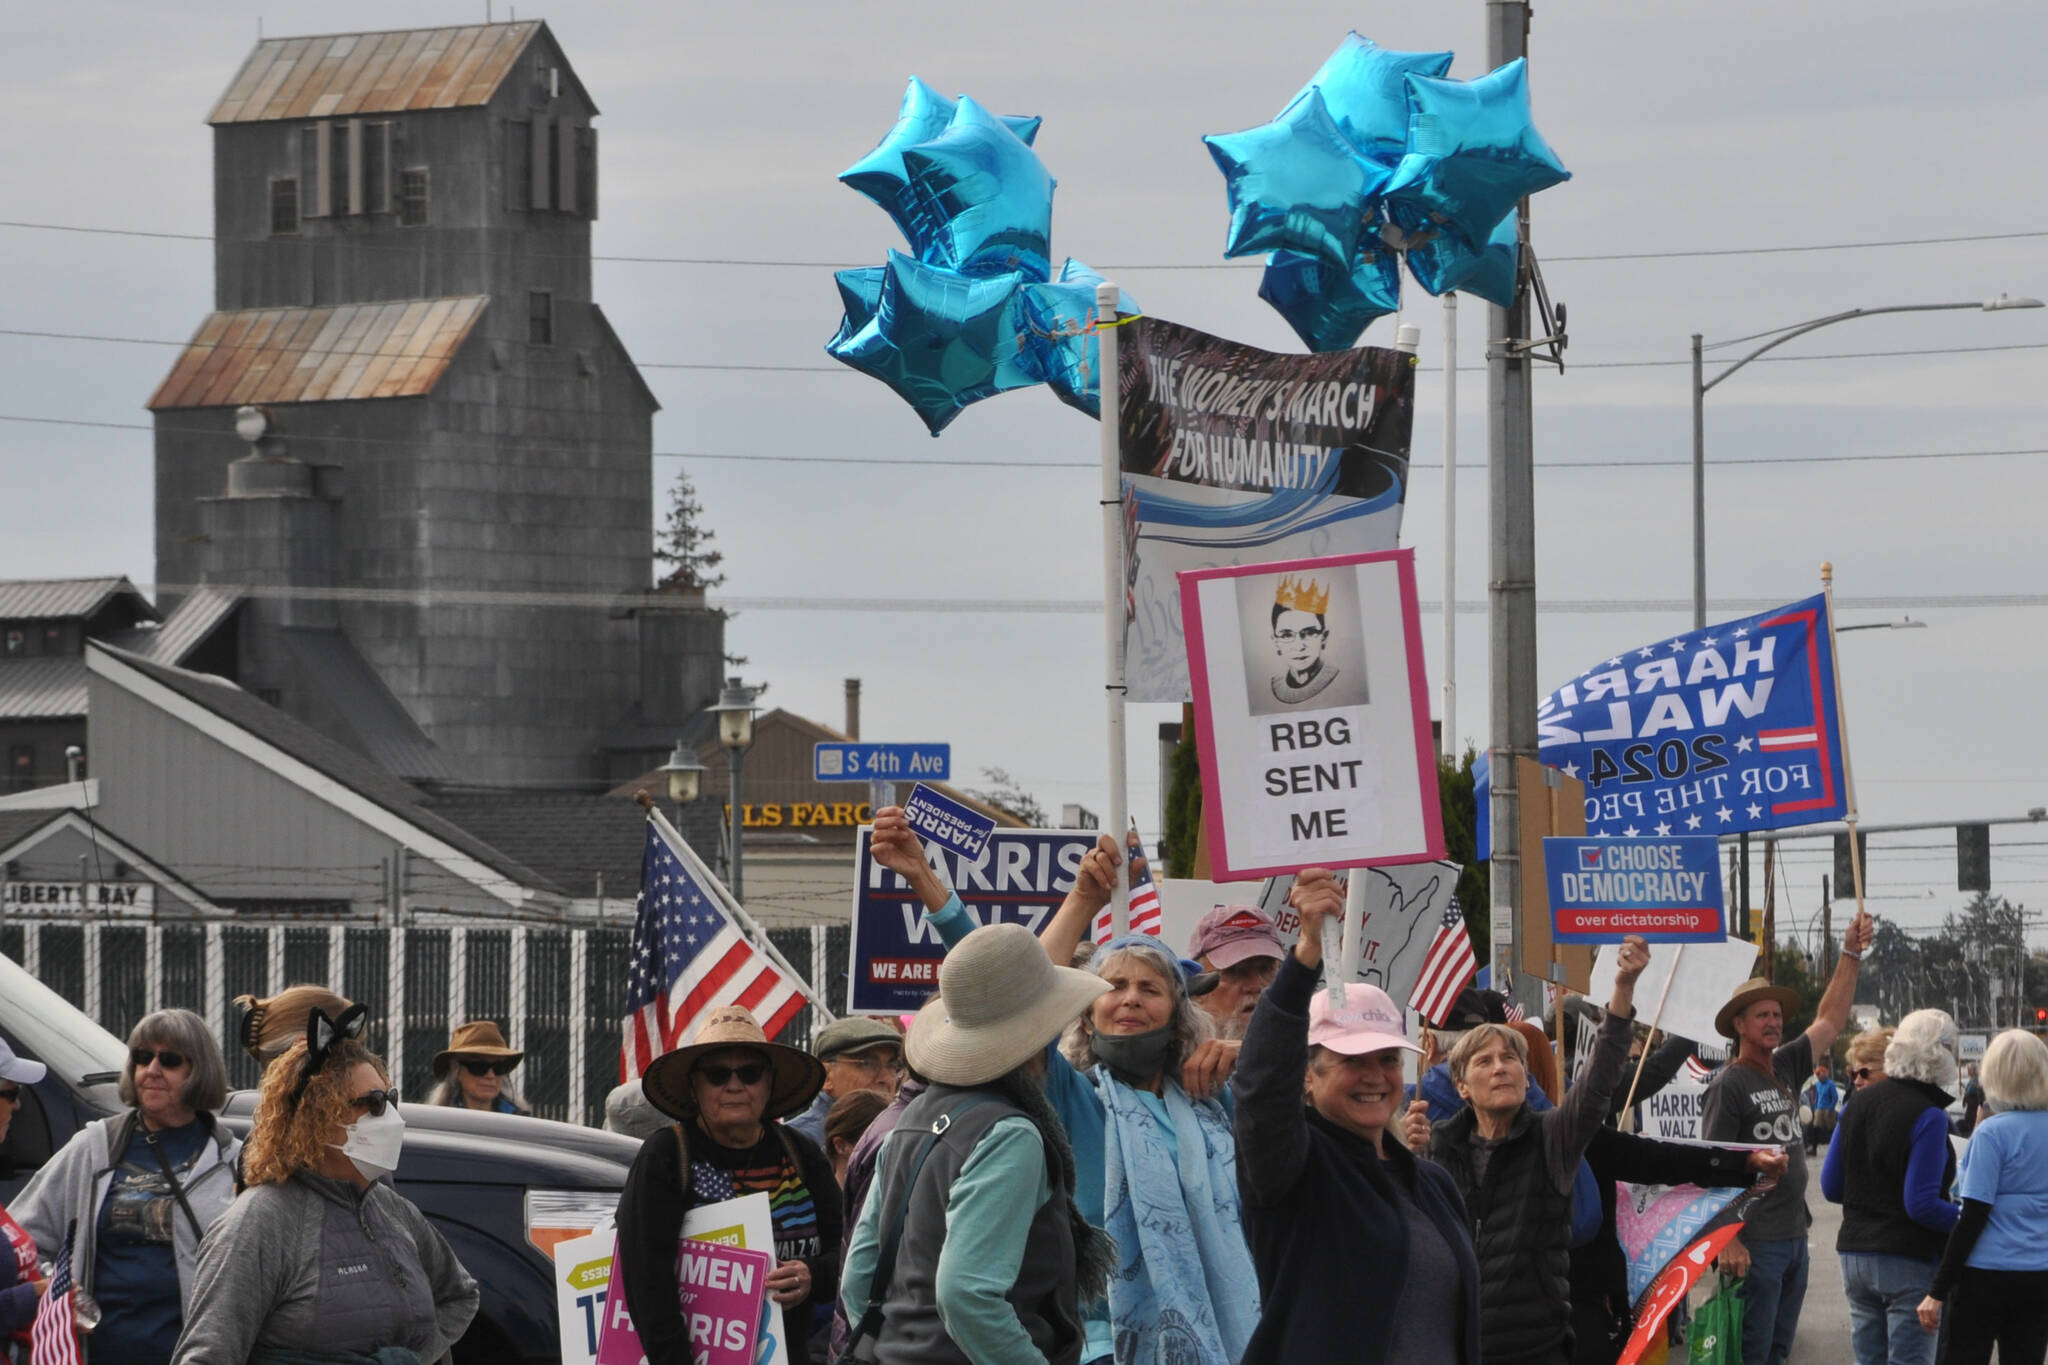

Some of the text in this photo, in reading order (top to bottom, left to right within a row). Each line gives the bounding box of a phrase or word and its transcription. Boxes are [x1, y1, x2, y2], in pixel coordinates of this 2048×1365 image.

[1149, 354, 1377, 430] THE WOMEN'S MARCH
[1163, 428, 1331, 490] FOR HUMANITY
[1270, 716, 1352, 752] RBG
[847, 751, 943, 774] S 4th Ave
[1265, 760, 1363, 797] SENT
[903, 803, 983, 855] HARRIS
[910, 796, 973, 832] PRESIDENT
[1290, 808, 1348, 841] ME
[1607, 845, 1684, 870] CHOOSE
[99, 886, 138, 905] BAY
[1562, 872, 1706, 902] DEMOCRACY
[1575, 912, 1700, 929] over dictatorship
[872, 963, 897, 980] WE
[900, 963, 932, 980] ARE
[1650, 1094, 1703, 1117] HARRIS
[1658, 1120, 1697, 1139] WALZ
[675, 1253, 755, 1295] MEN
